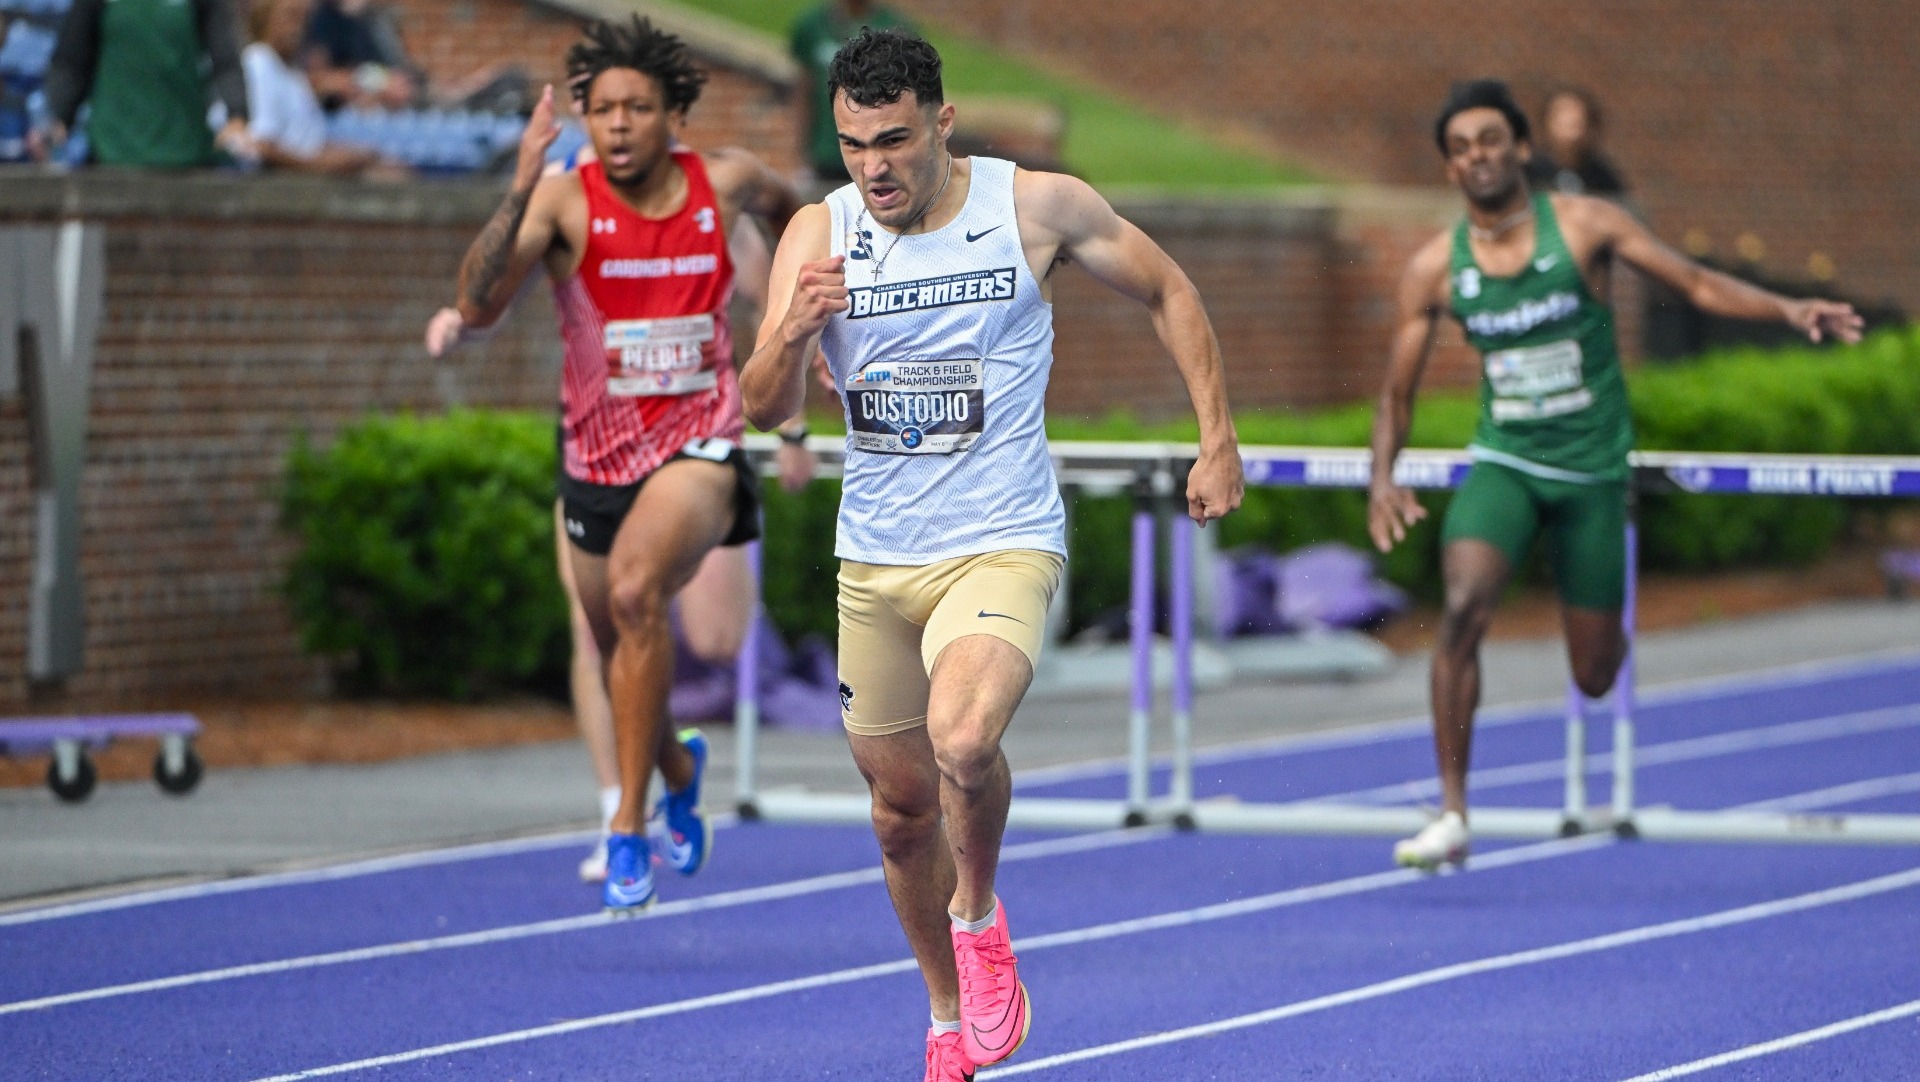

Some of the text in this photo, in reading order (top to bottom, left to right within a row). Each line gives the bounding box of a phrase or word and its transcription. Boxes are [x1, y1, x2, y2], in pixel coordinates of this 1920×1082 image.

[601, 255, 717, 278] GARDNER-WEBB
[876, 271, 989, 292] CHARLESTON SOUTHERN UNIVERSITY
[852, 271, 1013, 317] BUCCANEERS
[893, 374, 978, 386] CHAMPIONSHIPS
[898, 366, 931, 376] TRACK
[934, 365, 941, 375] &
[944, 364, 972, 375] FIELD
[861, 391, 969, 423] CUSTODIO
[1750, 468, 1894, 495] HIGH POINT
